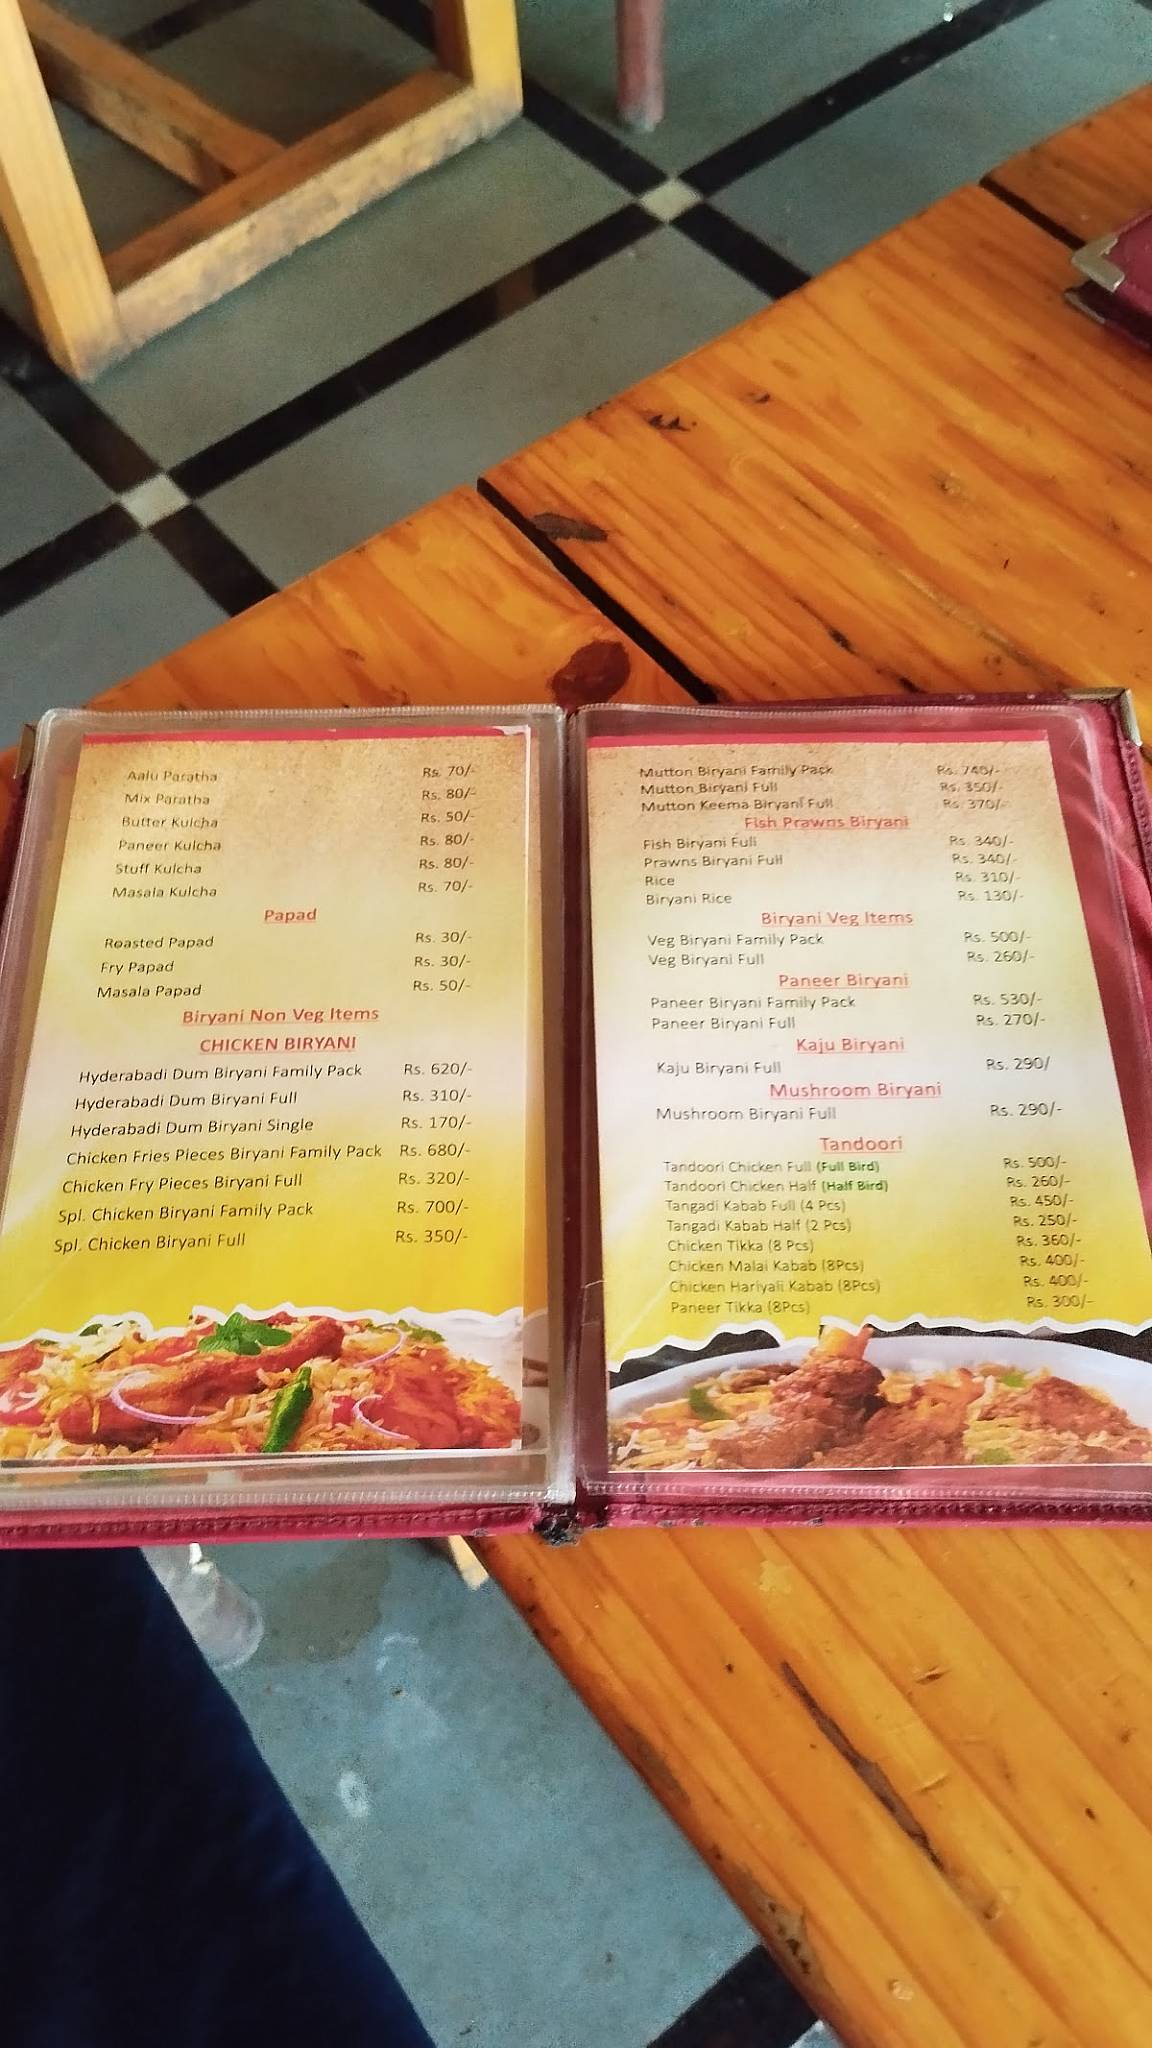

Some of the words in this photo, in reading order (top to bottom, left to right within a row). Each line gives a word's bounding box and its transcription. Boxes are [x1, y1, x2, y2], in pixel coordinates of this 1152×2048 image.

[641, 783, 695, 795] Mutton
[699, 781, 749, 797] Biryani
[752, 781, 778, 792] Full
[122, 816, 166, 828] Butter
[171, 817, 218, 829] Kulcha
[744, 817, 777, 829] Fish
[783, 816, 845, 828] Prawns
[849, 815, 909, 831] Biryani
[118, 840, 169, 851] Paneer
[173, 840, 221, 851] Kulcha
[643, 838, 671, 850] Fish
[675, 837, 727, 852] Biryani
[731, 837, 758, 848] Full
[115, 863, 149, 874] Stuff
[154, 863, 202, 874] Kulcha
[644, 856, 698, 868] Prawns
[701, 855, 753, 870] Biryani
[757, 854, 783, 866] Full
[645, 875, 675, 886] Rice
[112, 886, 165, 898] Masala
[169, 886, 217, 897] Kulcha
[646, 893, 697, 908] Biryani
[701, 893, 732, 904] Rice
[264, 909, 317, 924] Papad
[762, 913, 822, 928] Biryani
[827, 913, 860, 927] Veg
[864, 912, 913, 924] Items
[104, 937, 164, 949] Roasted
[168, 936, 214, 951] Papad
[648, 935, 675, 949] Veg
[679, 934, 733, 949] Biryani
[737, 933, 786, 948] Family
[789, 933, 824, 944] Pack
[964, 932, 985, 943] Rs.
[990, 931, 1031, 944] 500/-
[100, 962, 123, 976] Fry
[128, 960, 175, 975] Papad
[648, 955, 676, 969] Veg
[681, 954, 734, 968] Biryani
[738, 953, 764, 965] Full
[778, 975, 841, 987] Paneer
[846, 974, 908, 989] Biryani
[97, 986, 150, 998] Masala
[154, 984, 202, 999] Papad
[651, 998, 705, 1009] Paneer
[709, 997, 763, 1012] Biryani
[767, 997, 817, 1011] Family
[821, 997, 856, 1008] Pack
[183, 1010, 244, 1027] Biryani
[250, 1009, 286, 1022] Non
[292, 1008, 325, 1025] Veg
[329, 1008, 379, 1021] Items
[652, 1018, 706, 1030] Paneer
[710, 1018, 764, 1032] Biryani
[768, 1017, 796, 1029] Full
[976, 1015, 998, 1026] Rs.
[1003, 1014, 1046, 1027] 270/-
[200, 1038, 279, 1053] CHICKEN
[284, 1035, 356, 1050] BIRYANI
[796, 1038, 836, 1056] Kaju
[842, 1037, 905, 1055] Biryani
[404, 1063, 425, 1076] Rs.
[430, 1060, 473, 1077] 620/-
[657, 1063, 691, 1077] Kaju
[695, 1062, 749, 1077] Biryani
[753, 1062, 782, 1074] Full
[986, 1059, 1008, 1070] Rs.
[1013, 1057, 1050, 1071] 290/
[78, 1069, 168, 1088] Hyderabadi
[173, 1067, 210, 1082] Dum
[214, 1066, 268, 1083] Biryani
[272, 1064, 322, 1082] Family
[326, 1063, 362, 1077] Pack
[770, 1083, 871, 1097] Mushroom
[878, 1082, 942, 1099] Biryani
[74, 1095, 164, 1114] Hyderabadi
[169, 1094, 206, 1108] Dum
[211, 1092, 265, 1110] Biryani
[269, 1091, 298, 1105] Full
[990, 1104, 1013, 1116] Rs.
[1018, 1103, 1063, 1117] 290/-
[656, 1108, 744, 1120] Mushroom
[749, 1108, 804, 1122] Biryani
[809, 1108, 837, 1119] Full
[70, 1122, 161, 1141] Hyderabadi
[165, 1121, 203, 1135] Dum
[208, 1119, 262, 1137] Biryani
[266, 1118, 314, 1135] Single
[401, 1117, 423, 1130] Rs.
[430, 1115, 472, 1131] 170/-
[820, 1138, 903, 1151] Tandoori
[66, 1151, 128, 1166] Chicken
[132, 1150, 170, 1164] Fries
[175, 1148, 225, 1163] Pieces
[229, 1147, 285, 1164] Biryani
[289, 1145, 341, 1163] Family
[346, 1144, 382, 1158] Pack
[664, 1162, 725, 1173] Tandoori
[729, 1161, 783, 1173] Chicken
[787, 1161, 813, 1173] Full
[816, 1161, 845, 1175] (Full
[848, 1161, 880, 1175] Bird)
[62, 1179, 124, 1194] Chicken
[129, 1178, 155, 1195] Fry
[158, 1177, 209, 1191] Pieces
[214, 1175, 269, 1193] Biryani
[274, 1173, 302, 1187] Full
[398, 1172, 420, 1185] Rs.
[426, 1170, 470, 1186] 320/-
[664, 1181, 726, 1192] Tandoori
[730, 1180, 785, 1192] Chicken
[789, 1180, 818, 1192] Half
[821, 1180, 854, 1194] (Half
[858, 1180, 889, 1194] Bird)
[58, 1209, 86, 1226] Spl.
[92, 1207, 154, 1222] Chicken
[159, 1205, 215, 1223] Biryani
[220, 1203, 272, 1221] Family
[277, 1202, 313, 1216] Pack
[665, 1200, 720, 1215] Tangadi
[724, 1200, 767, 1212] Kabab
[771, 1200, 796, 1212] Full
[800, 1200, 813, 1214] (4
[818, 1200, 846, 1214] Pcs)
[666, 1220, 720, 1234] Tangadi
[725, 1220, 769, 1231] Kabab
[773, 1220, 802, 1231] Half
[805, 1219, 819, 1233] (2
[824, 1219, 852, 1233] Pcs)
[53, 1238, 82, 1255] Spl.
[88, 1236, 151, 1251] Chicken
[156, 1234, 212, 1252] Biryani
[217, 1233, 246, 1247] Full
[395, 1231, 417, 1243] Rs.
[423, 1229, 468, 1244] 350/-
[668, 1240, 723, 1251] Chicken
[727, 1240, 763, 1251] Tikka
[767, 1239, 782, 1253] (8
[785, 1239, 814, 1253] Pcs)
[668, 1260, 724, 1271] Chicken
[728, 1260, 768, 1271] Malai
[773, 1260, 817, 1271] Kabab
[821, 1260, 864, 1274] (8Pcs)
[669, 1280, 726, 1292] Chicken
[730, 1280, 783, 1294] Hariyali
[788, 1280, 833, 1292] Kabab
[837, 1280, 881, 1294] (8Pcs)
[670, 1301, 720, 1313] Paneer
[725, 1301, 762, 1313] Tikka
[767, 1301, 810, 1315] (8Pcs)
